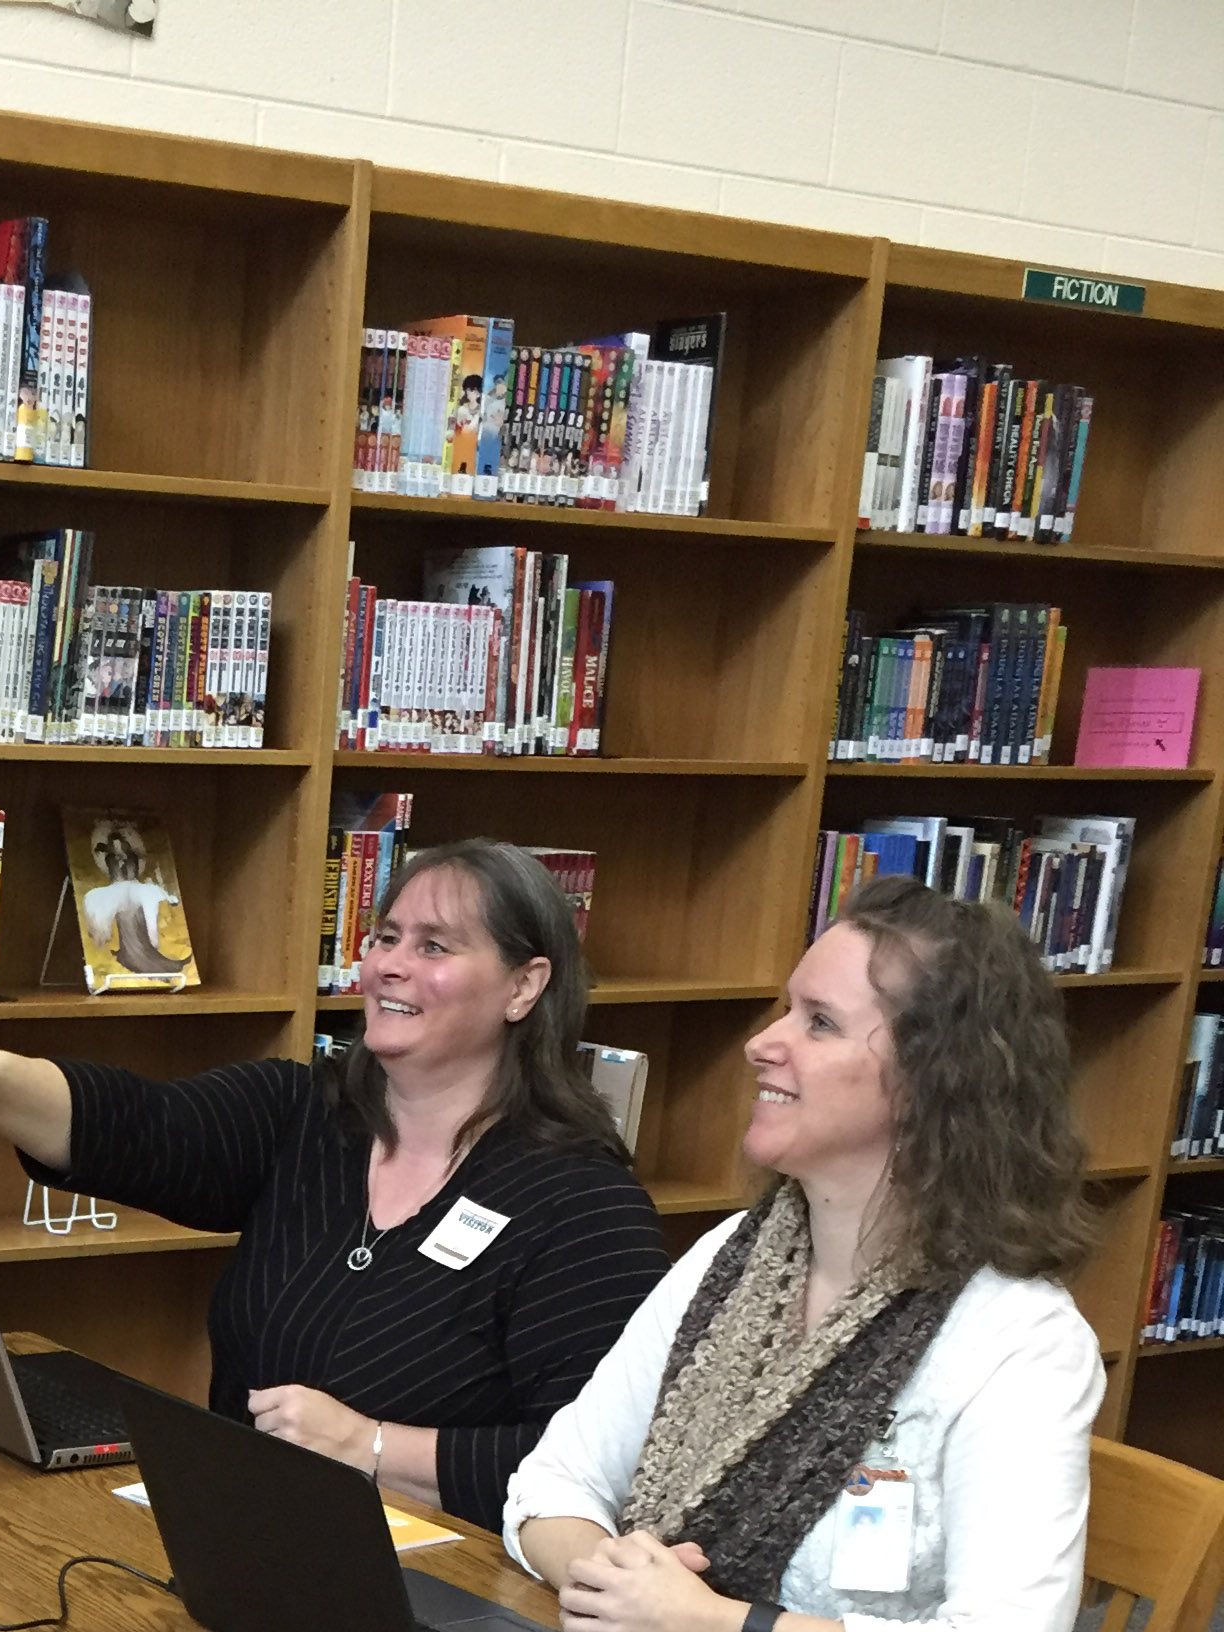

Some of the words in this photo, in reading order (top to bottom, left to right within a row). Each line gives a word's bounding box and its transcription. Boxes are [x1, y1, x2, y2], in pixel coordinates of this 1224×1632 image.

[1052, 276, 1119, 307] FICTION
[514, 408, 522, 422] 2
[526, 406, 534, 419] 3
[537, 411, 544, 425] 5
[547, 410, 555, 424] 6
[558, 410, 565, 423] 7
[567, 412, 576, 426] 8
[576, 414, 584, 428] 9
[646, 410, 658, 457] ARSLAN
[659, 410, 670, 457] ARSLAN
[1007, 424, 1020, 468] REALITY
[1002, 469, 1015, 505] CHECK
[156, 616, 166, 652] SCOTT
[177, 616, 187, 652] SCOTT
[199, 616, 209, 652] SCOTT
[152, 654, 162, 702] PILGRIM
[197, 653, 206, 702] PILGRIM
[560, 655, 574, 698] HAVOC
[582, 654, 598, 709] MALICE
[991, 639, 1005, 697] DOUGLAS
[1012, 640, 1025, 697] DOUGLAS
[1032, 640, 1046, 697] DOUGLAS
[350, 860, 358, 898] AMERICAN
[362, 858, 375, 907] BOXERS
[458, 1211, 496, 1235] VISITOR
